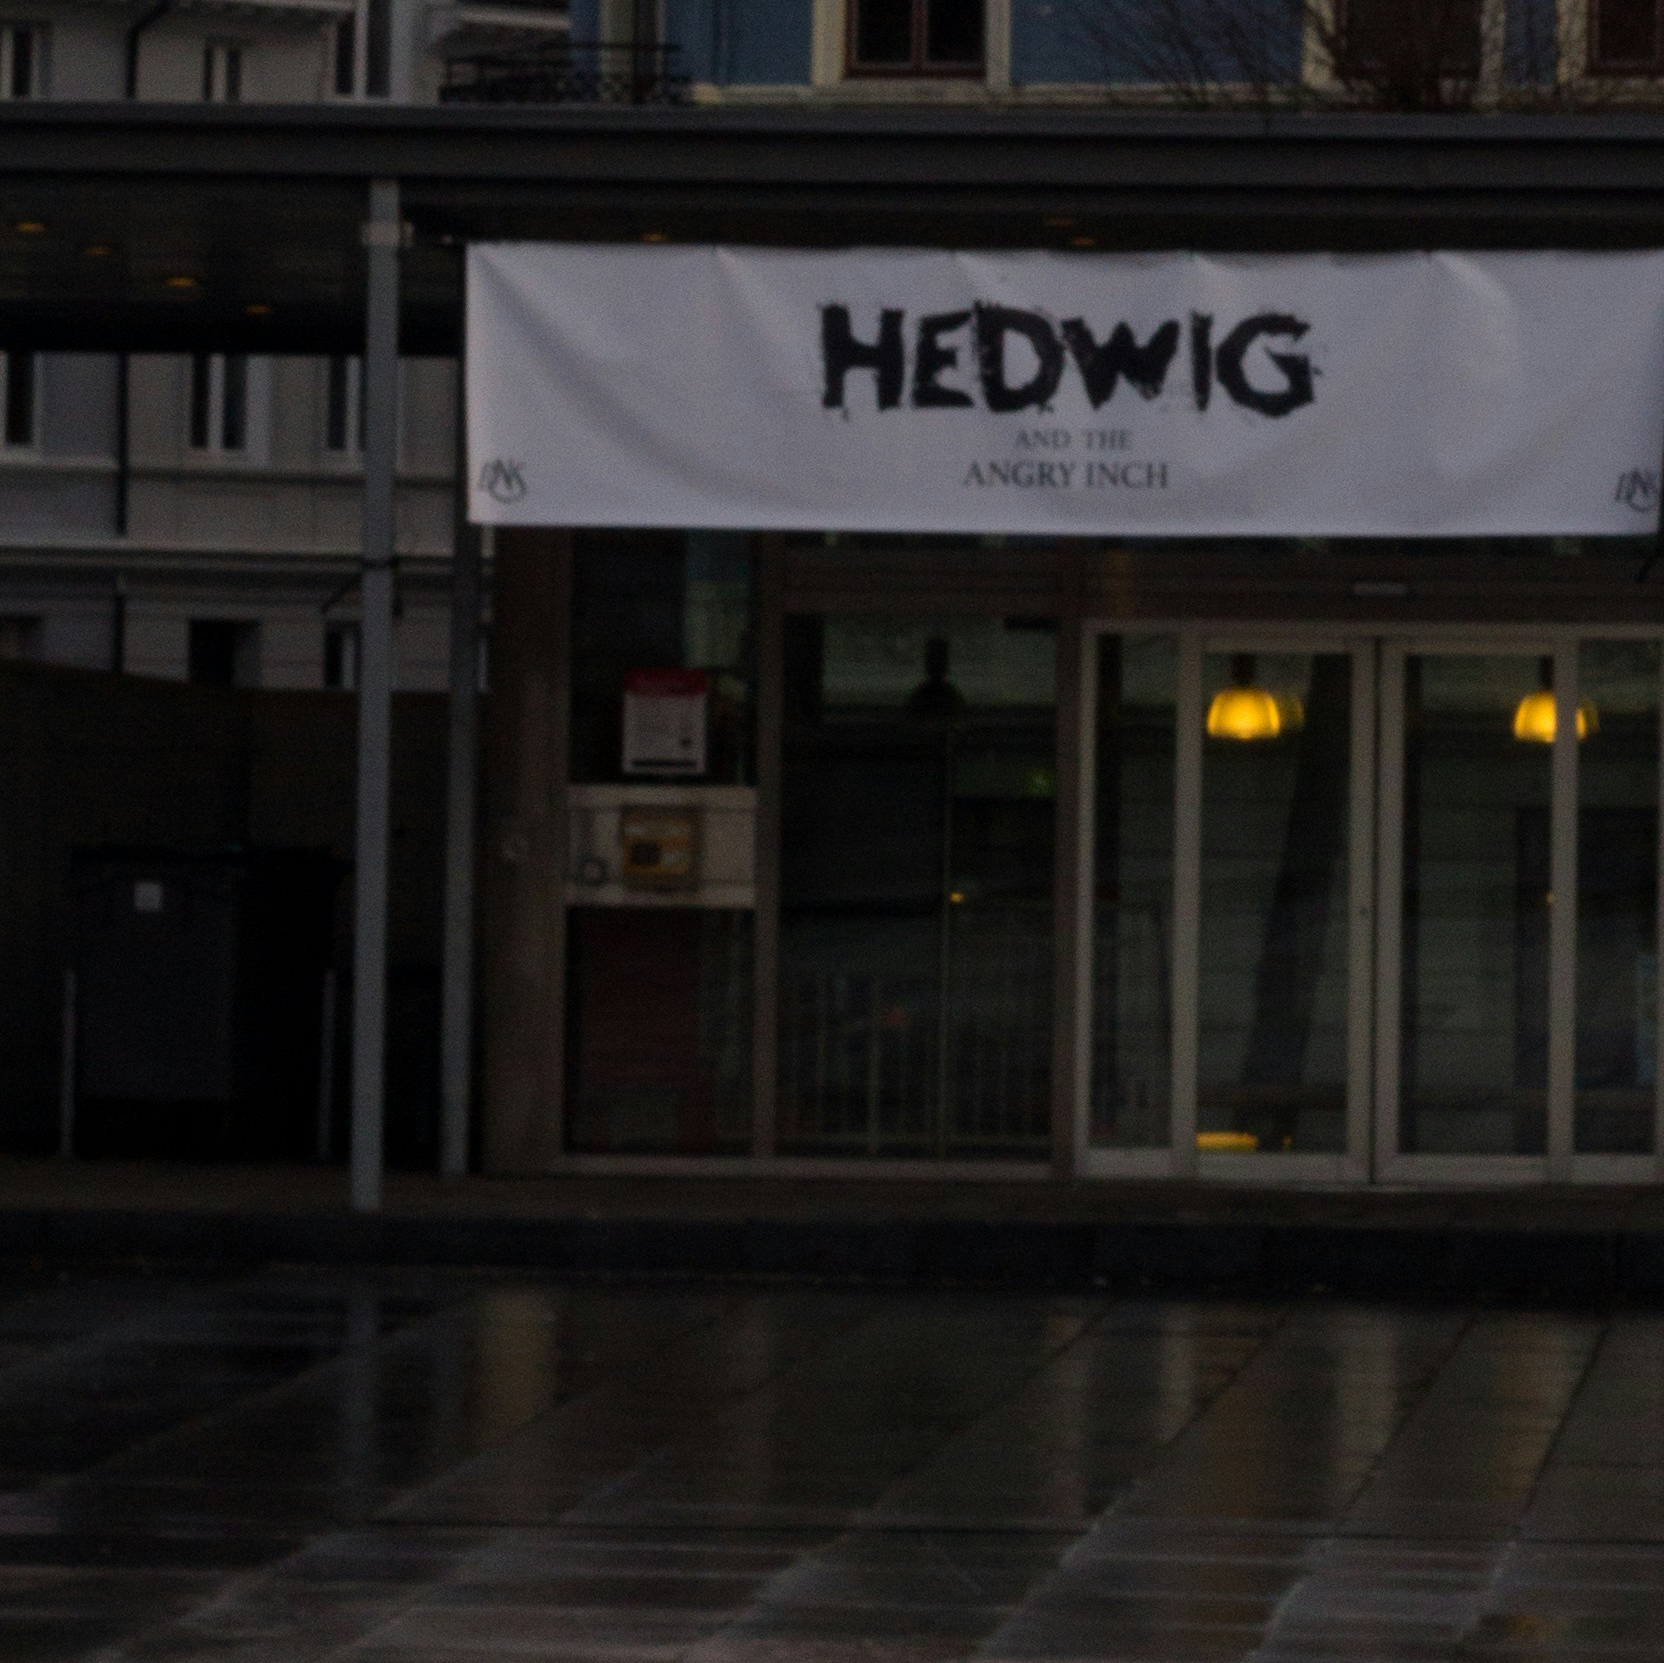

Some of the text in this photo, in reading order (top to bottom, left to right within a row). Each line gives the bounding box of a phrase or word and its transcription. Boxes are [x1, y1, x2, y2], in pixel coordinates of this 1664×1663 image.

[819, 301, 1320, 418] HEDWIG
[1014, 429, 1132, 450] AND THE
[963, 461, 1169, 490] ANGRY INCH
